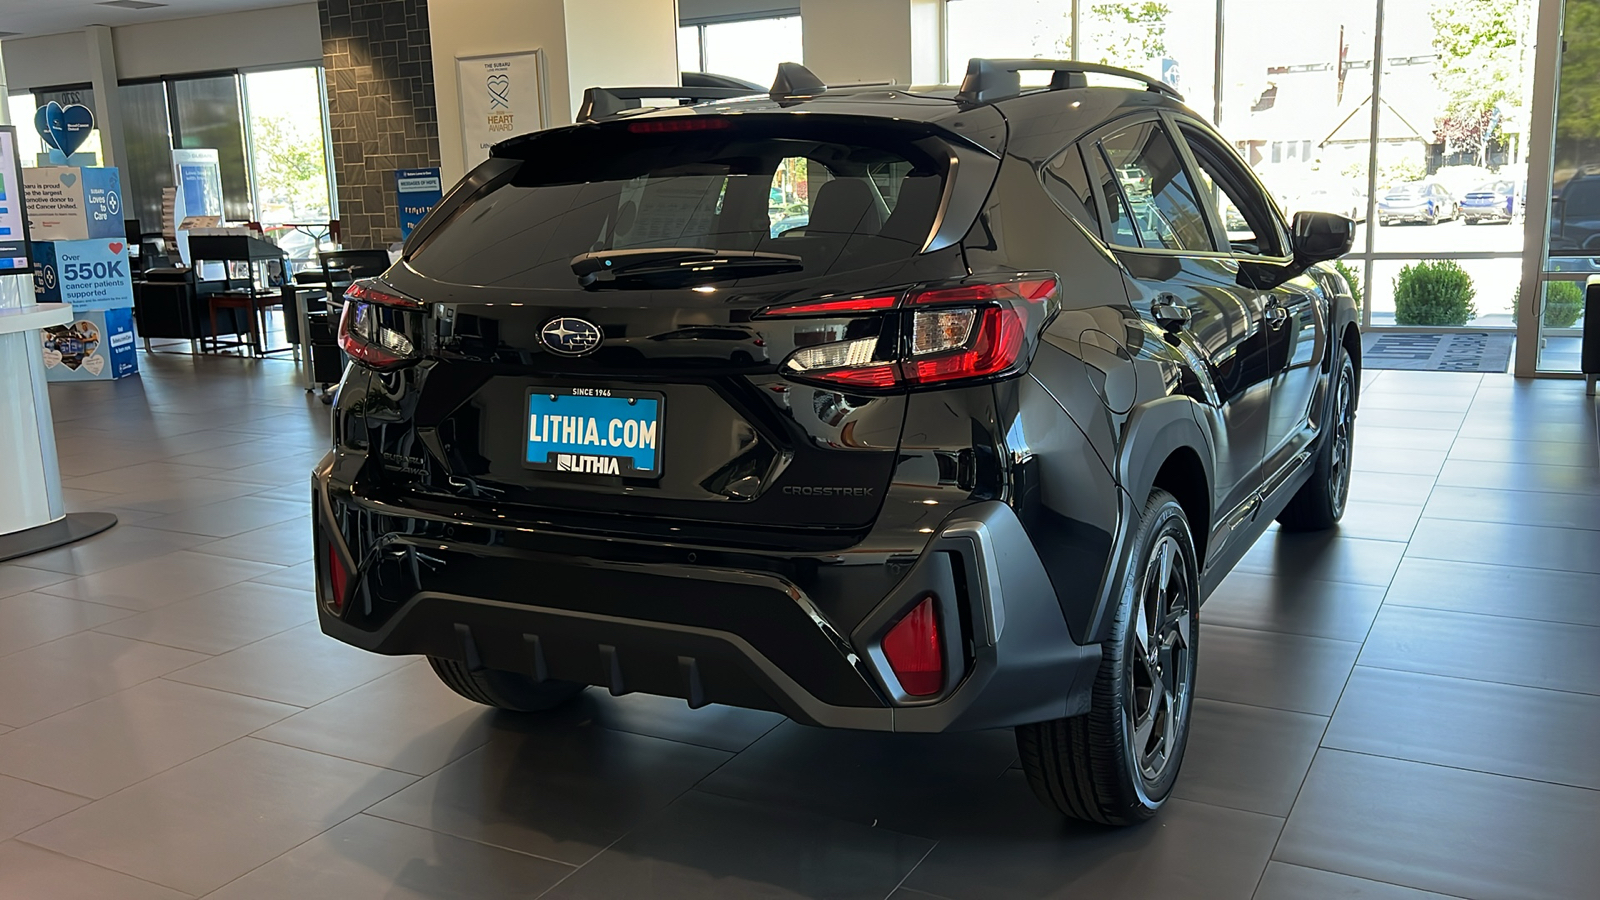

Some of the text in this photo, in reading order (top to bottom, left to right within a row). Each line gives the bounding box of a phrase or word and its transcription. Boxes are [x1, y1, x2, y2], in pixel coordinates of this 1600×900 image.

[488, 115, 513, 124] HEART
[489, 124, 513, 132] AWARD
[88, 195, 105, 204] Loves
[94, 212, 107, 220] Care
[64, 261, 124, 280] 550K
[94, 280, 124, 290] patients
[67, 290, 107, 298] supported
[1363, 334, 1444, 359] LITHIA
[530, 414, 657, 449] LITHIA.COM
[383, 452, 424, 464] SUBARU
[571, 454, 620, 475] LITHIA
[782, 486, 874, 496] CROSSTREK
